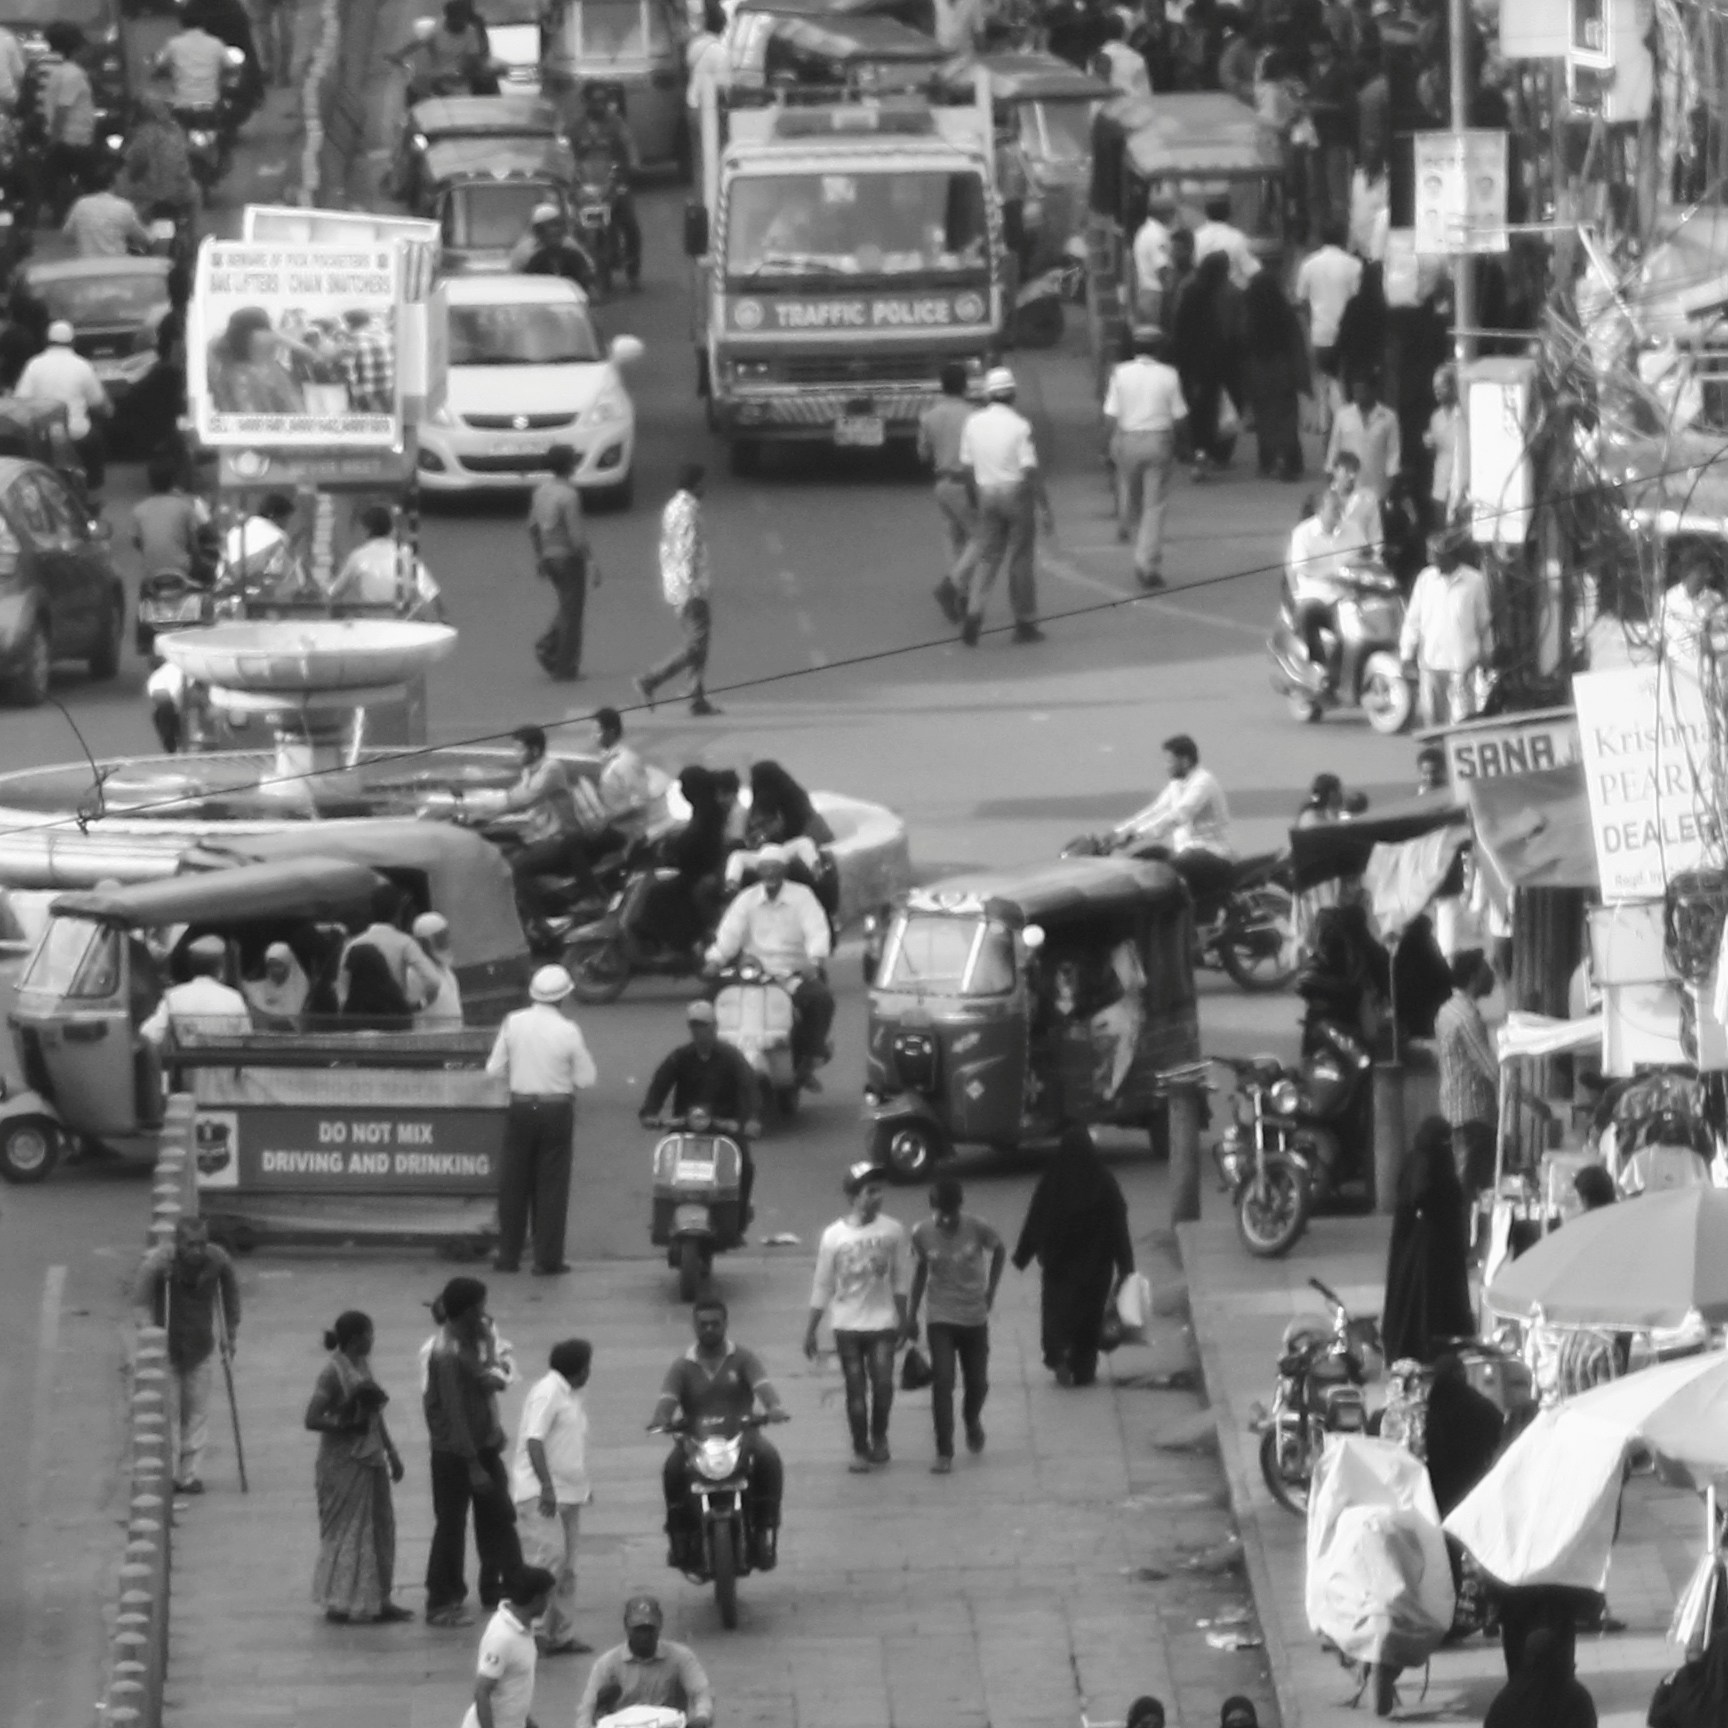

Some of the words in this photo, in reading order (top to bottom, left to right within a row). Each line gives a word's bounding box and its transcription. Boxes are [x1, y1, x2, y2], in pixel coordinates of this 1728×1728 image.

[775, 301, 866, 327] TRAFFIC
[872, 298, 951, 325] POLICE
[1455, 734, 1556, 780] SANA
[319, 1122, 348, 1144] DO
[352, 1122, 392, 1144] NOT
[397, 1123, 433, 1144] MIX
[262, 1150, 343, 1173] DRIVING
[348, 1152, 390, 1174] AND
[395, 1153, 490, 1176] DRINKING
